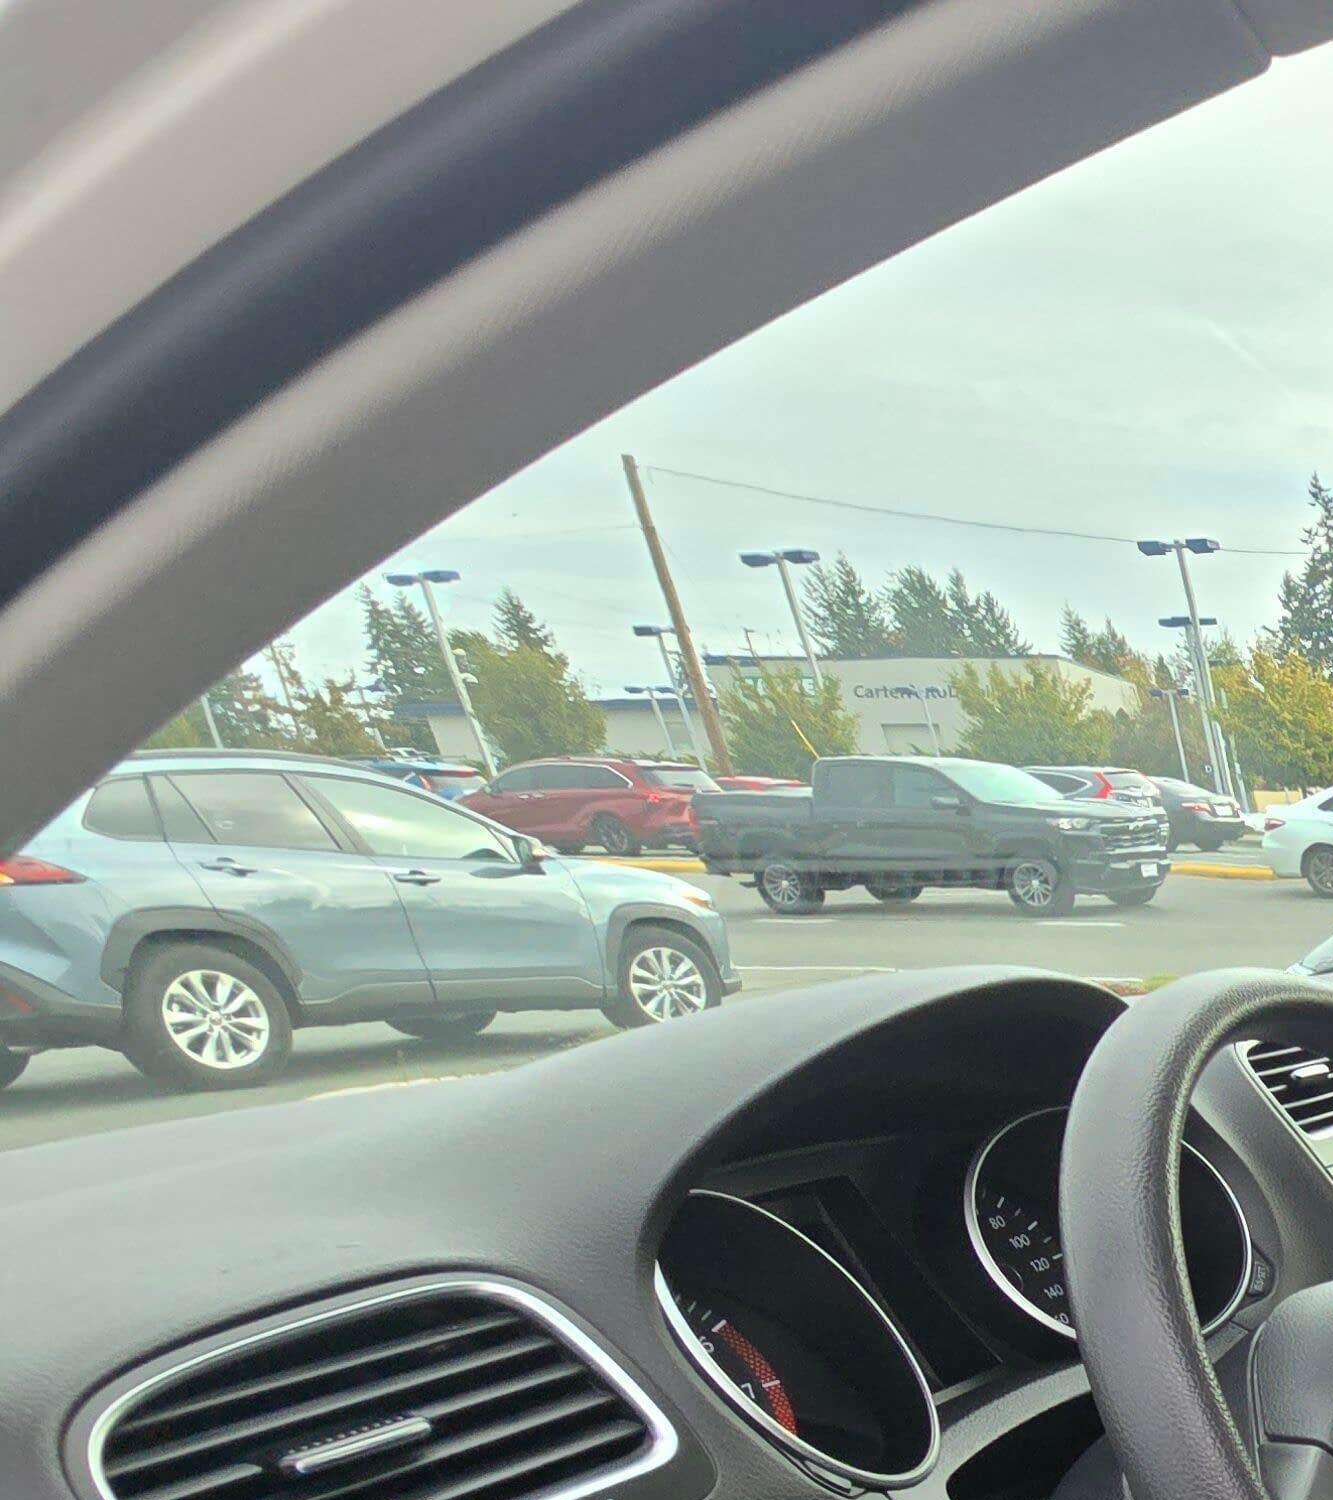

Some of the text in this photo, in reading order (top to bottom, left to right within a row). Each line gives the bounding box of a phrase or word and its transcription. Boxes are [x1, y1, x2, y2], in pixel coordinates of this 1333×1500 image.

[988, 1215, 1006, 1230] 80
[1009, 1233, 1031, 1249] 100
[1030, 1257, 1050, 1272] 120
[1044, 1284, 1064, 1299] 140
[740, 1382, 756, 1399] 7
